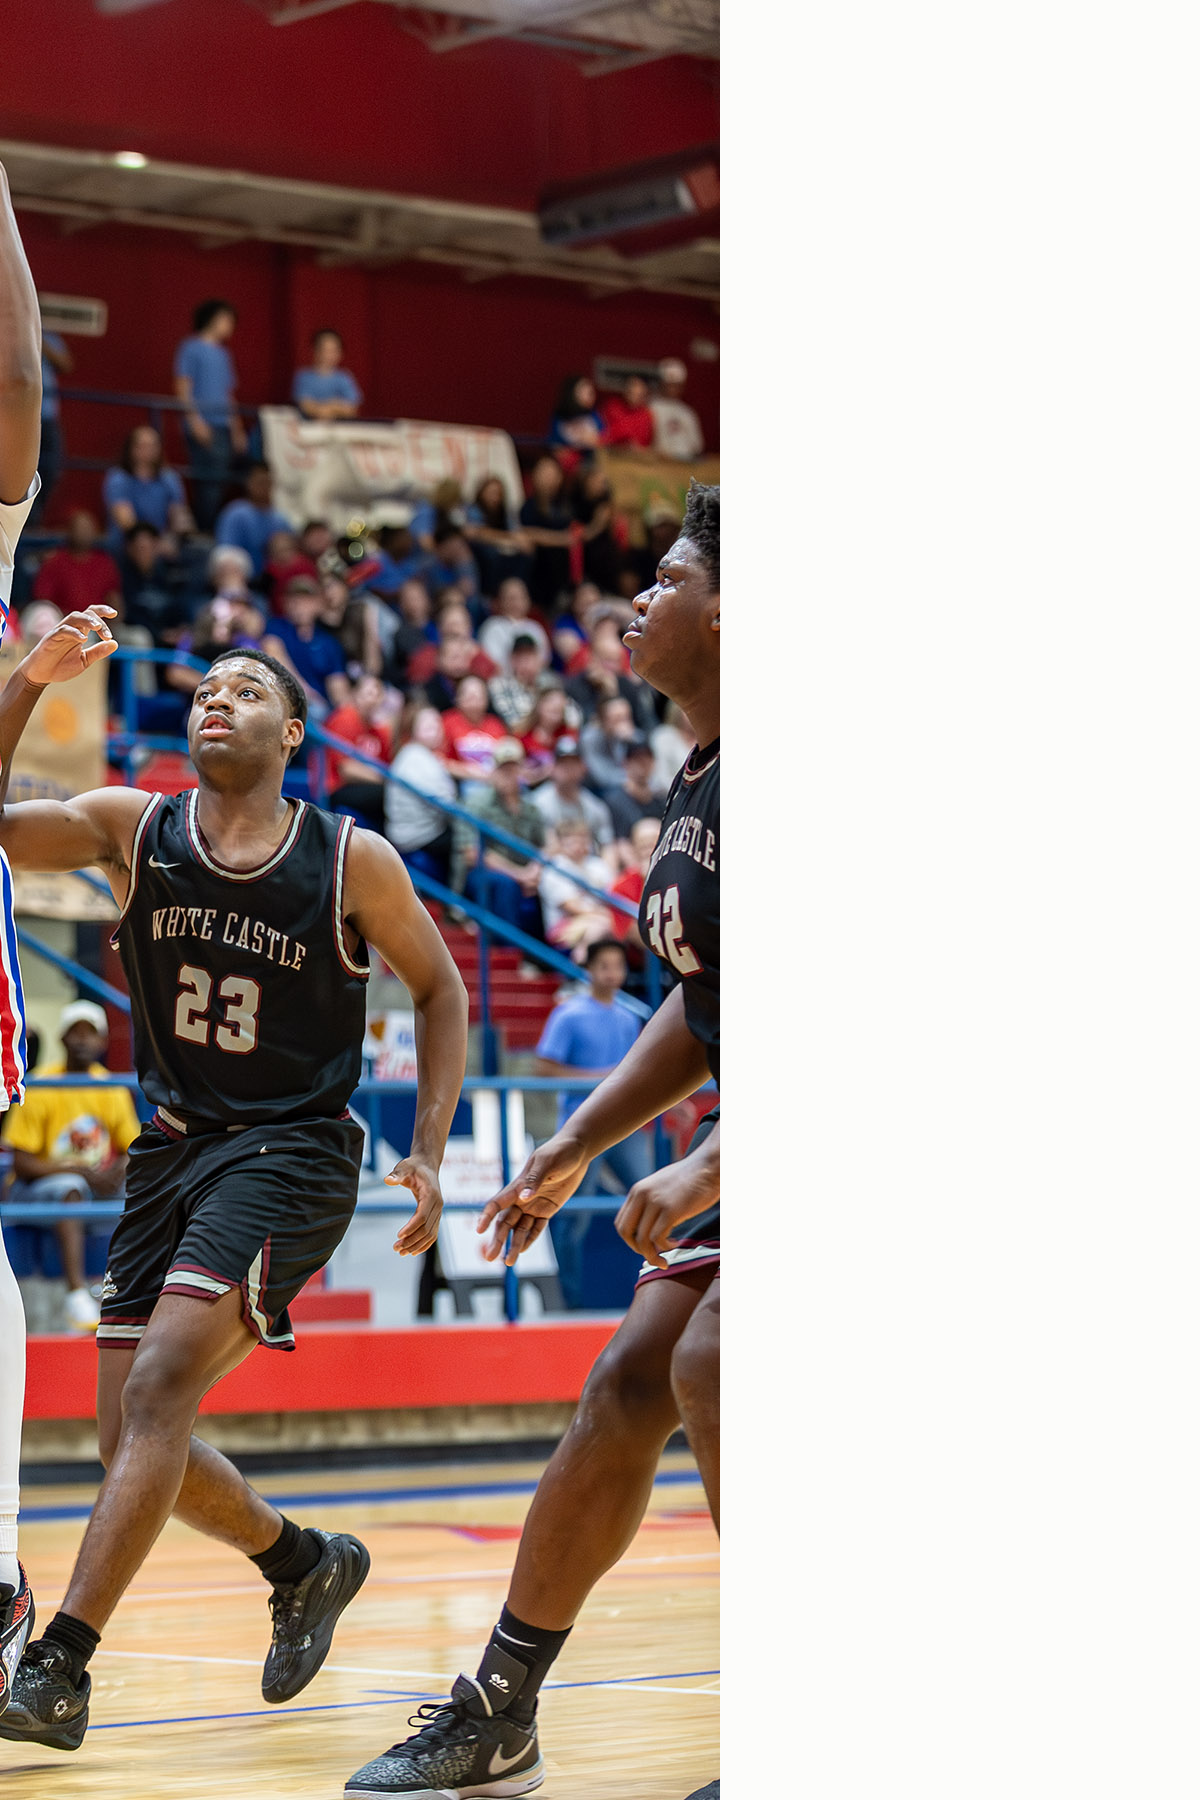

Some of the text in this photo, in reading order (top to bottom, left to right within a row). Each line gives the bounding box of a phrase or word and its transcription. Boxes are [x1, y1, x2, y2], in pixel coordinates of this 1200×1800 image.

[152, 905, 307, 971] WHITE CASTLE
[646, 883, 704, 977] 32
[174, 962, 262, 1055] 23
